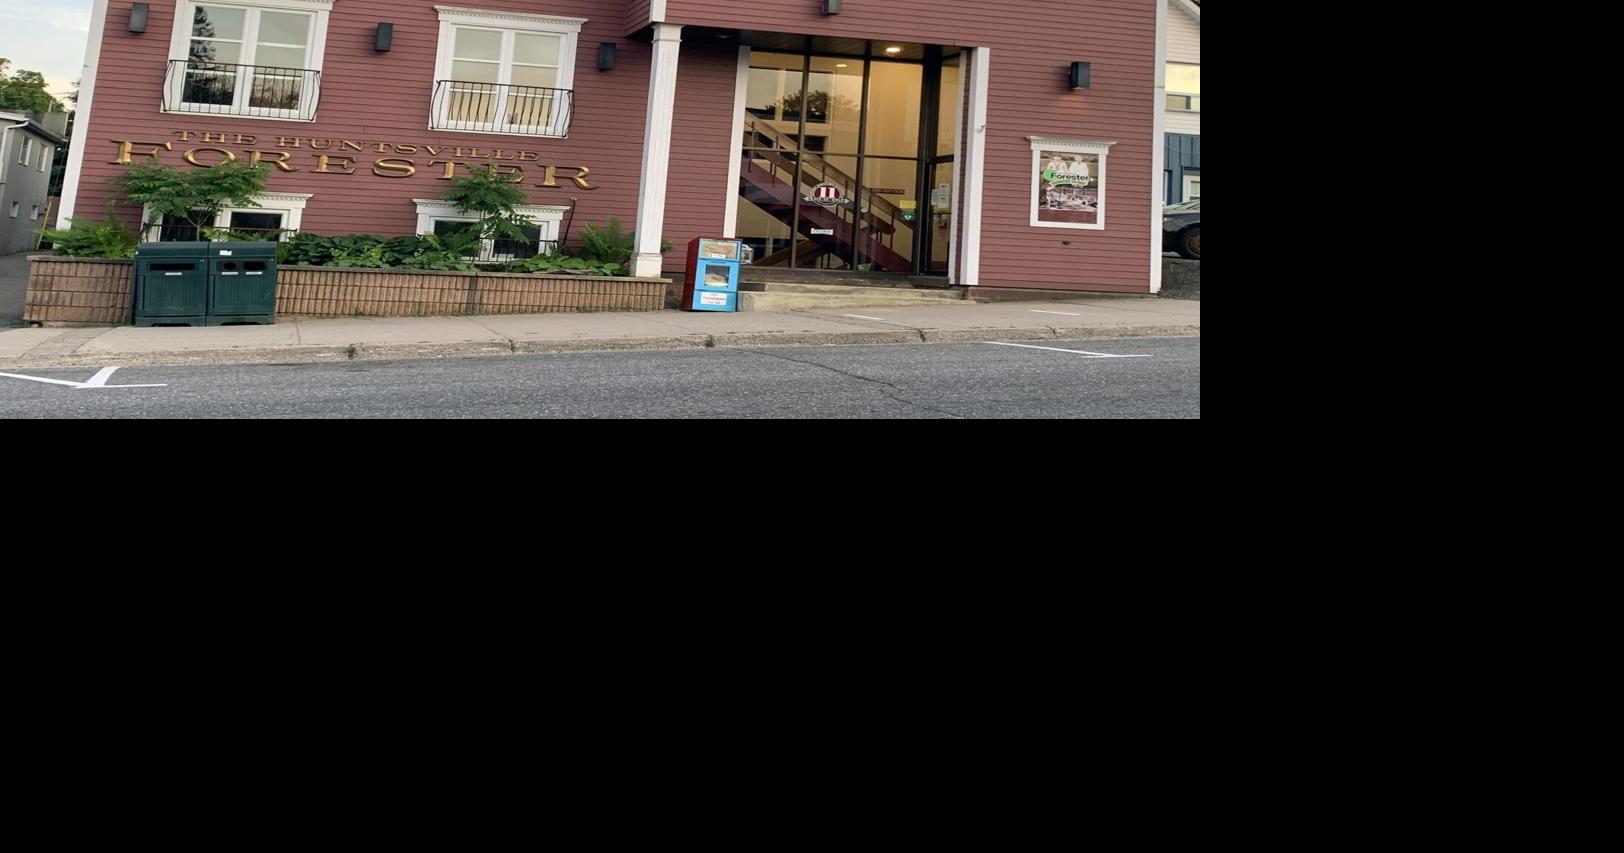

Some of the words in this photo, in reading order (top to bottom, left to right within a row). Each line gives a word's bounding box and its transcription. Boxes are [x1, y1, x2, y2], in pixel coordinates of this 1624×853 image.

[108, 139, 600, 190] FORESTER
[172, 130, 259, 146] THE
[277, 136, 540, 161] HUNTSVILLE
